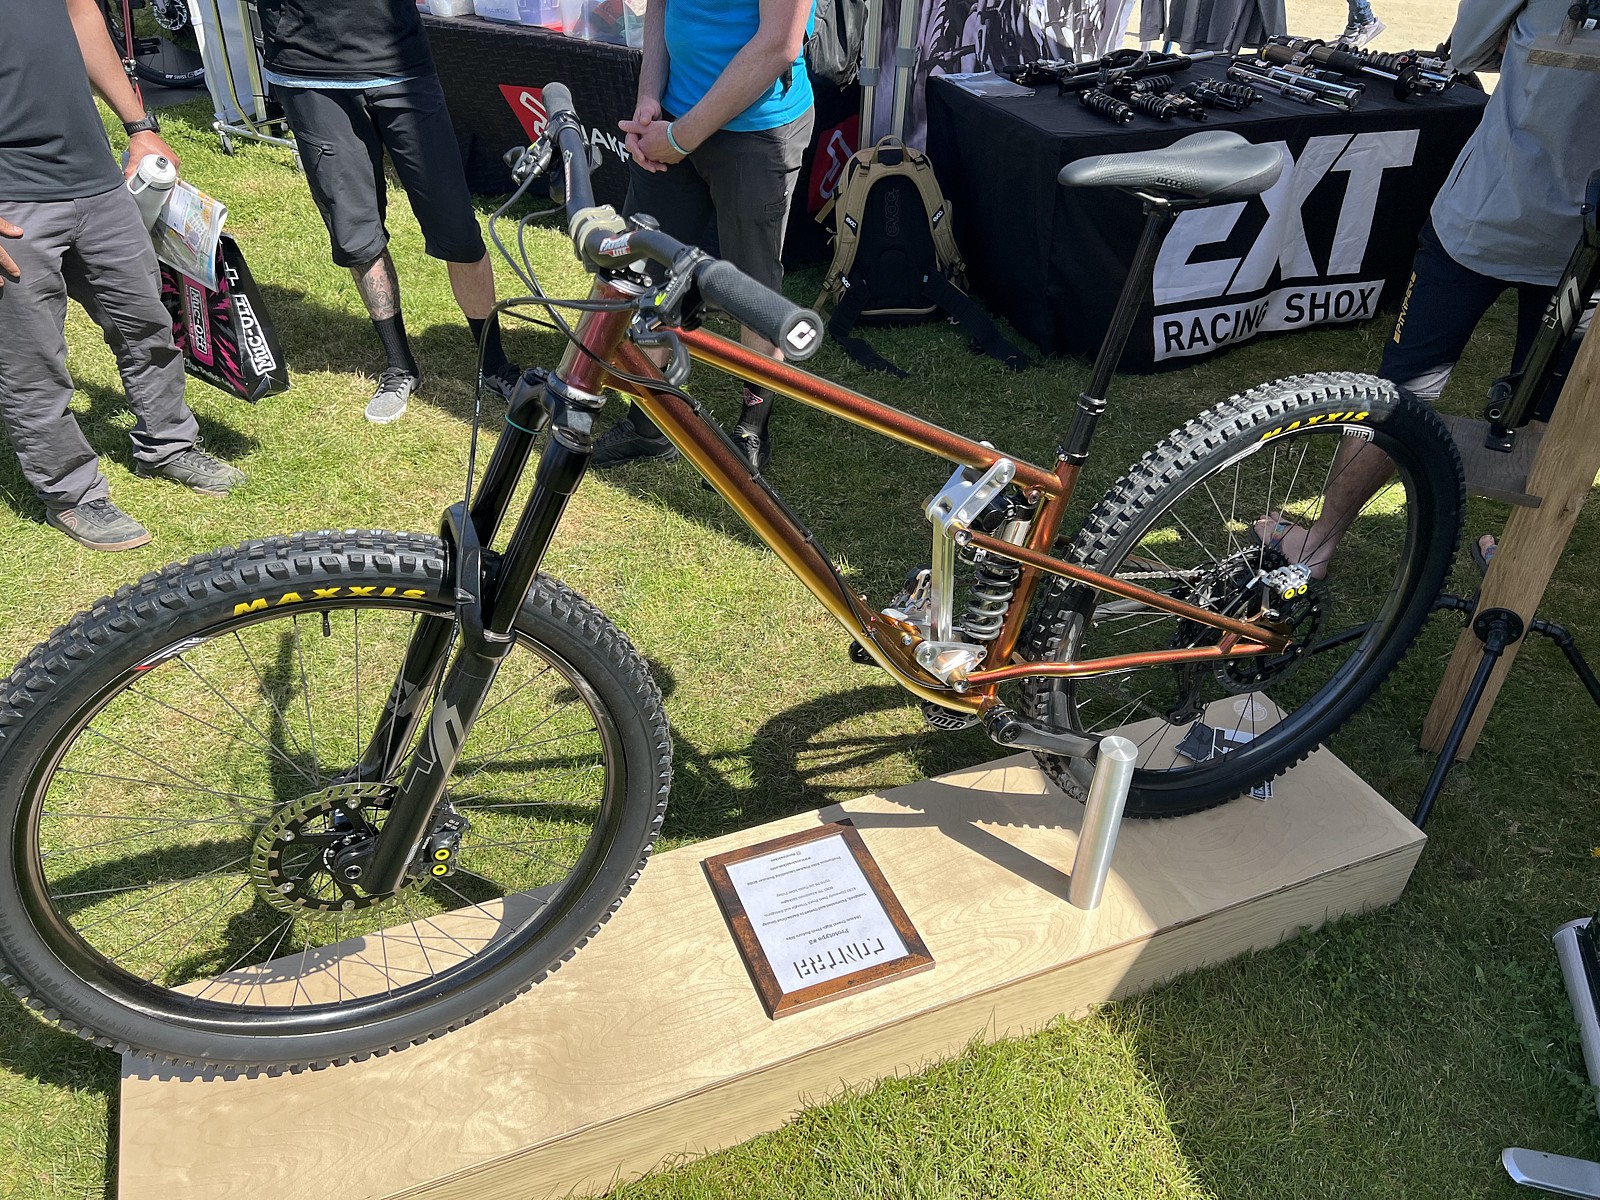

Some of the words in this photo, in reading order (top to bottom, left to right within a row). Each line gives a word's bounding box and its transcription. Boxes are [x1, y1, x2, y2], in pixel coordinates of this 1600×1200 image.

[1153, 129, 1420, 307] EXT
[1162, 299, 1269, 353] RACING
[1283, 286, 1376, 323] SHOX
[1260, 411, 1370, 441] MAXXIS
[233, 586, 426, 616] MAXXIS
[816, 928, 849, 941] Prototype
